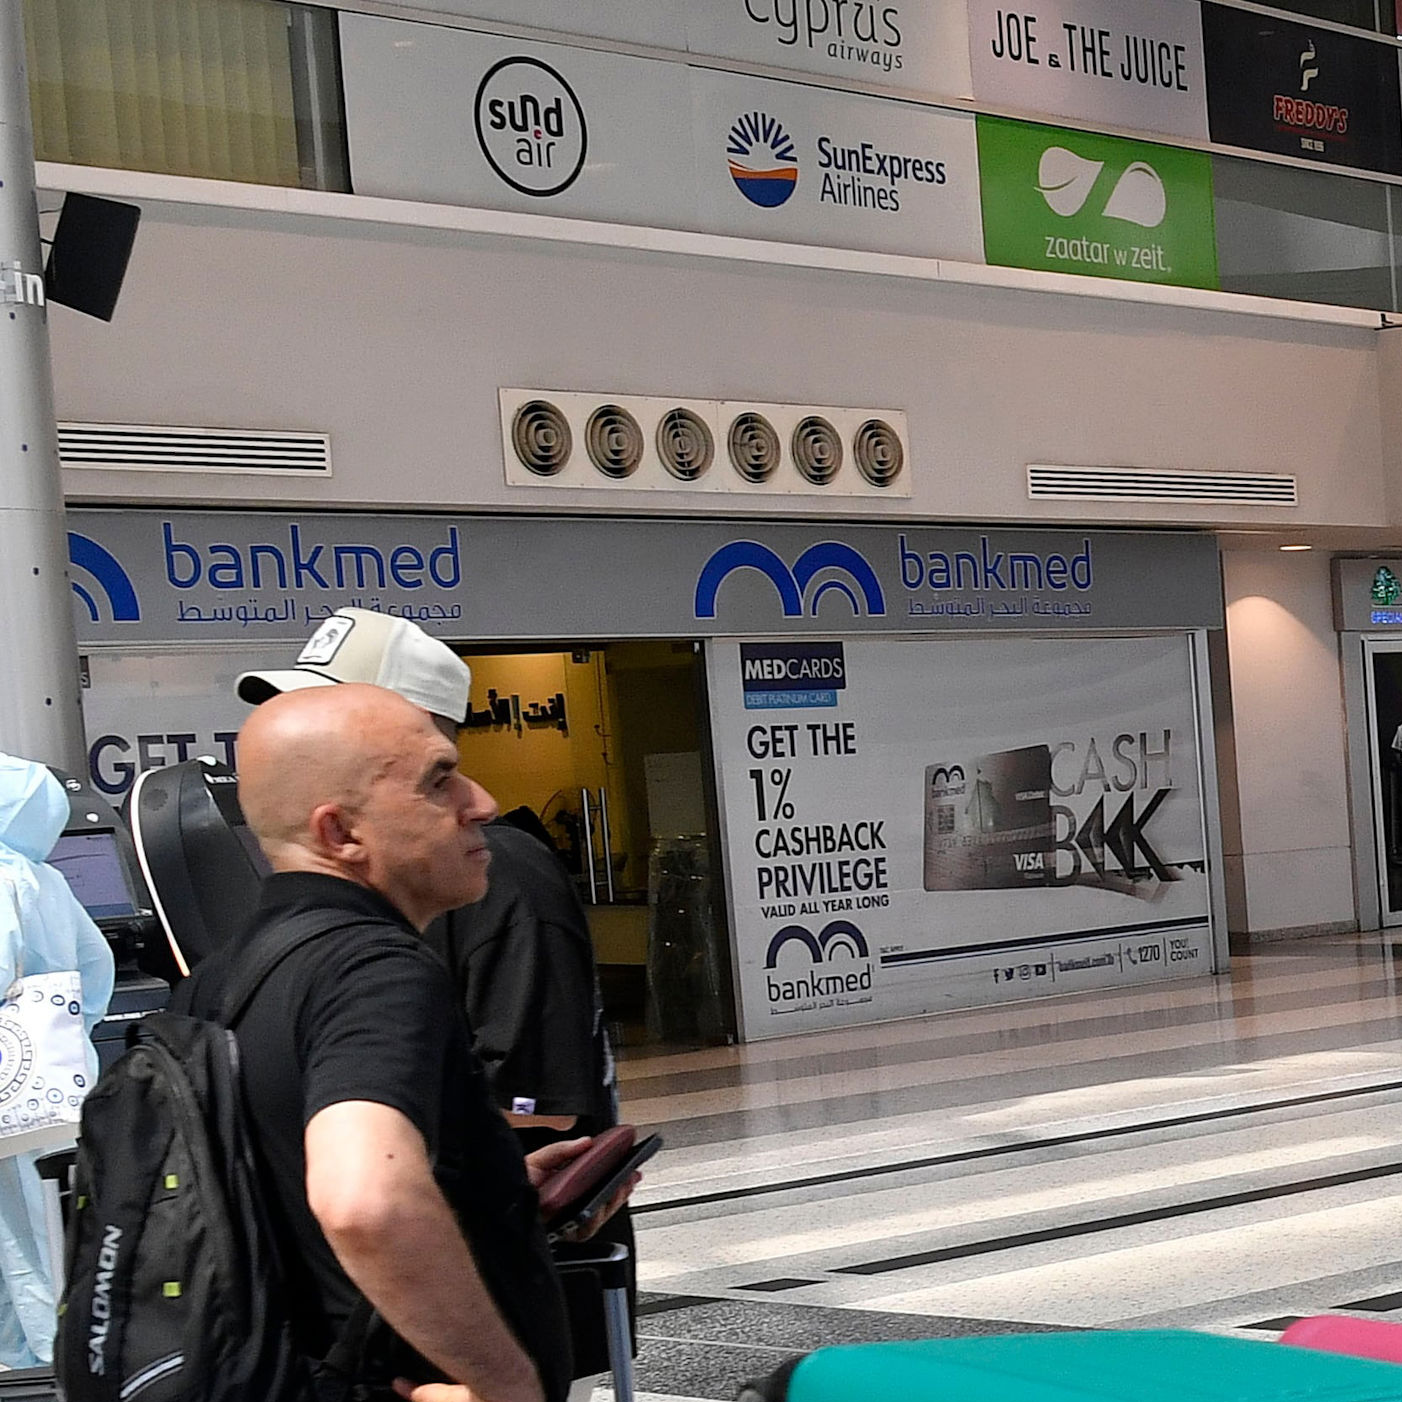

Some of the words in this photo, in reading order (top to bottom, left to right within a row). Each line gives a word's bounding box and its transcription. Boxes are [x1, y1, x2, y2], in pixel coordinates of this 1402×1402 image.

[827, 40, 903, 72] airways
[991, 10, 1040, 65] JOE
[1048, 53, 1062, 69] &
[1062, 22, 1113, 79] THE
[1120, 34, 1189, 92] JUICE
[1273, 94, 1348, 133] FREDDY'S
[515, 132, 556, 169] air
[817, 136, 947, 187] SunExpress
[819, 172, 901, 213] Airlines
[1045, 234, 1110, 265] zaatar
[1113, 249, 1128, 267] w
[162, 521, 463, 591] bankmed
[897, 533, 1093, 592] bankmed
[176, 598, 297, 628] المتوسط
[744, 657, 844, 681] MEDCARDS
[747, 724, 799, 760] GET
[806, 722, 857, 756] THE
[88, 732, 197, 795] GET
[1050, 728, 1173, 798] CASH
[749, 767, 796, 822] 1%
[754, 820, 888, 859] CASHBACK
[757, 856, 889, 900] PRIVILEGE
[1012, 852, 1046, 872] VISA
[761, 903, 796, 920] VALID
[800, 901, 821, 916] ALL
[823, 897, 854, 913] YEAR
[857, 894, 890, 910] LONG
[1138, 944, 1161, 963] 1270
[767, 963, 873, 1003] bankmed
[88, 1223, 123, 1377] SALOMON
